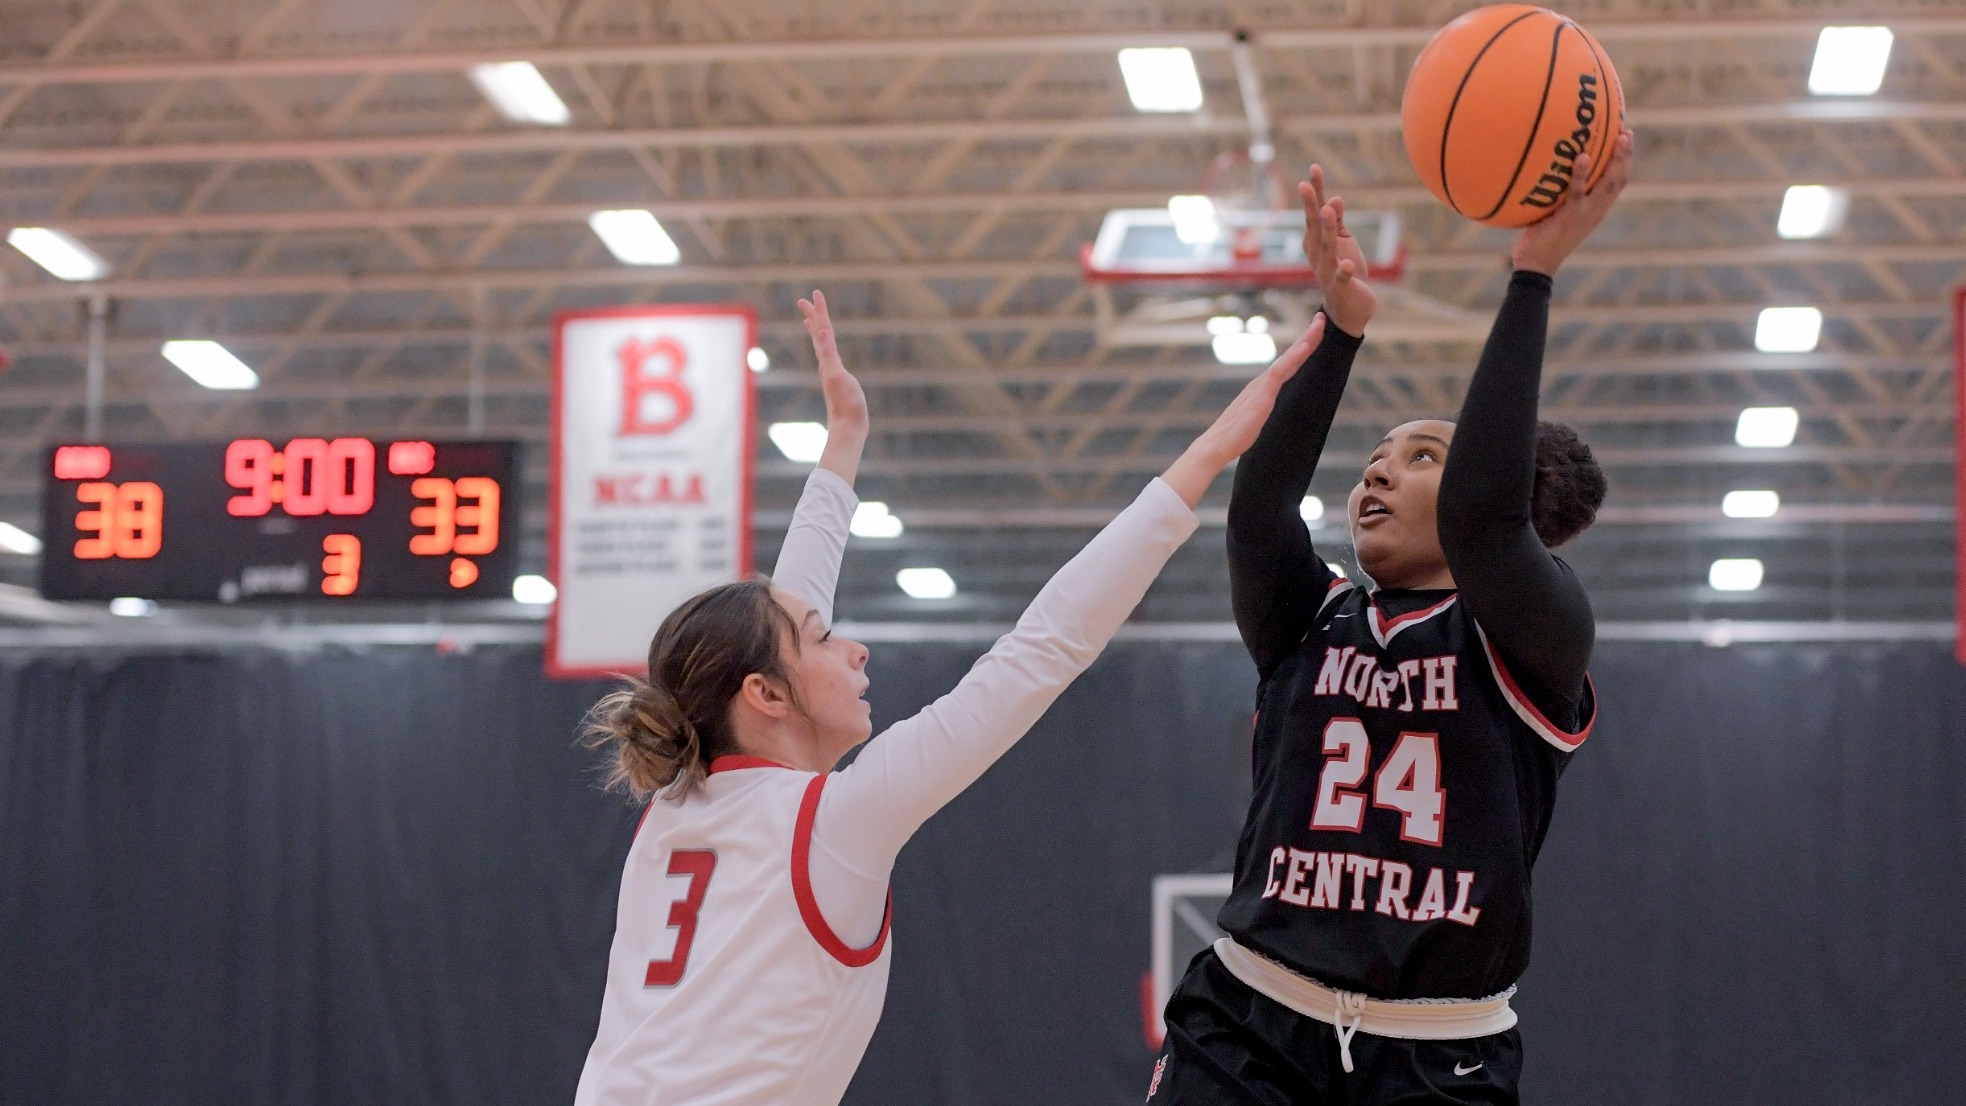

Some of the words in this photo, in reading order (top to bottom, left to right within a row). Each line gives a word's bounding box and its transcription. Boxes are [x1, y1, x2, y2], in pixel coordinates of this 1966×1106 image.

[1519, 73, 1597, 209] Wilson
[616, 336, 694, 437] B
[225, 438, 375, 516] 9:00
[409, 477, 500, 555] 33
[592, 472, 708, 507] NCAA
[74, 481, 164, 559] 38
[321, 534, 361, 595] 3
[1314, 646, 1459, 712] NORTH
[1309, 716, 1447, 848] 24
[643, 848, 718, 989] 3
[1261, 846, 1481, 926] CENTRAL
